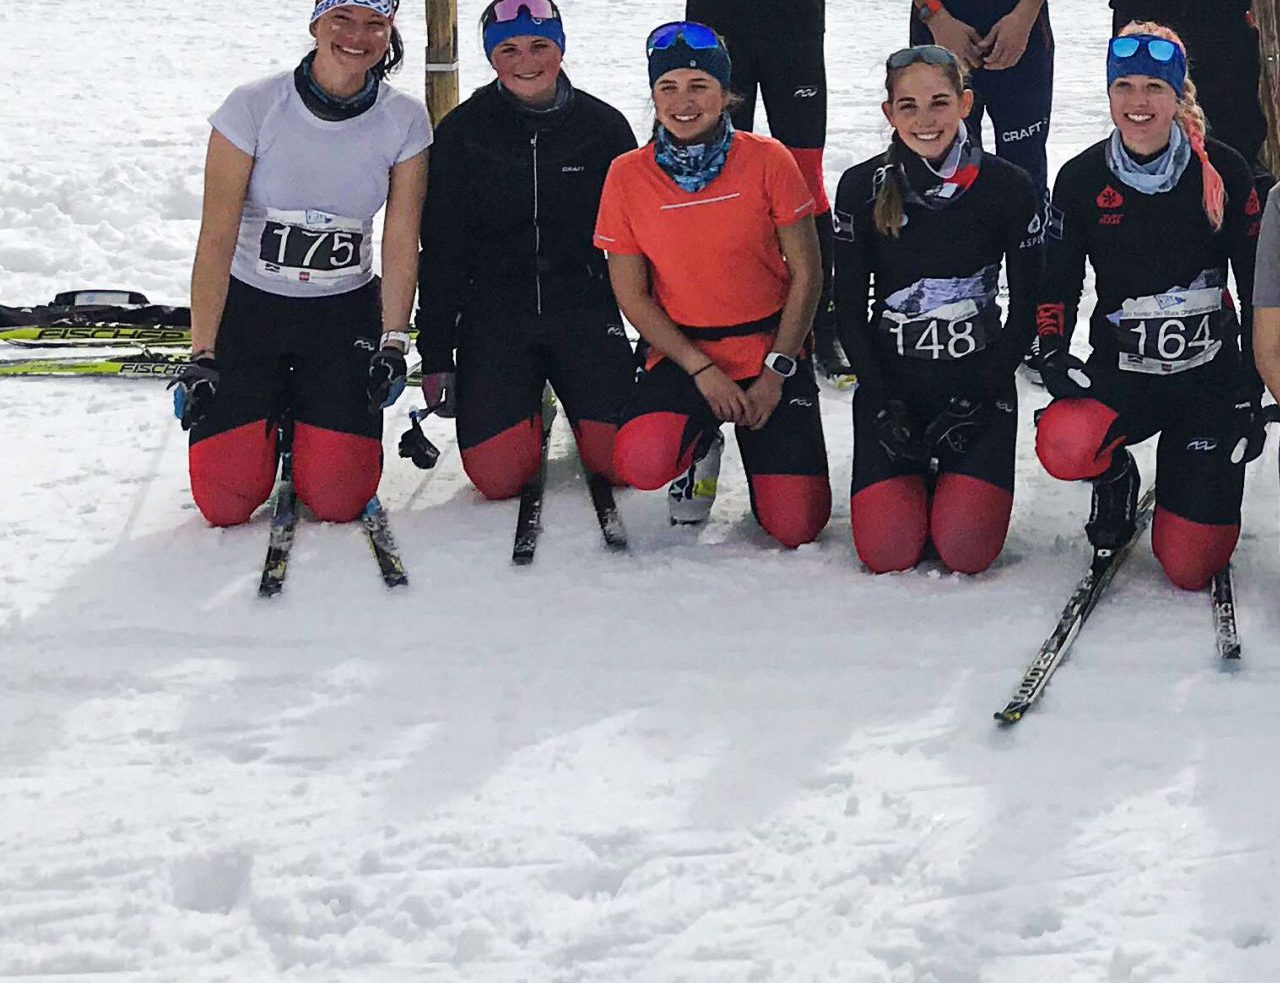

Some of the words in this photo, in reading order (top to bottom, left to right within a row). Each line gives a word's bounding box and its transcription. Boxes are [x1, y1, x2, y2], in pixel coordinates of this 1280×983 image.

[1003, 121, 1043, 142] CRAFT
[273, 225, 354, 267] 175
[37, 329, 185, 339] FISCHER
[890, 320, 976, 359] 148
[1130, 315, 1215, 359] 164
